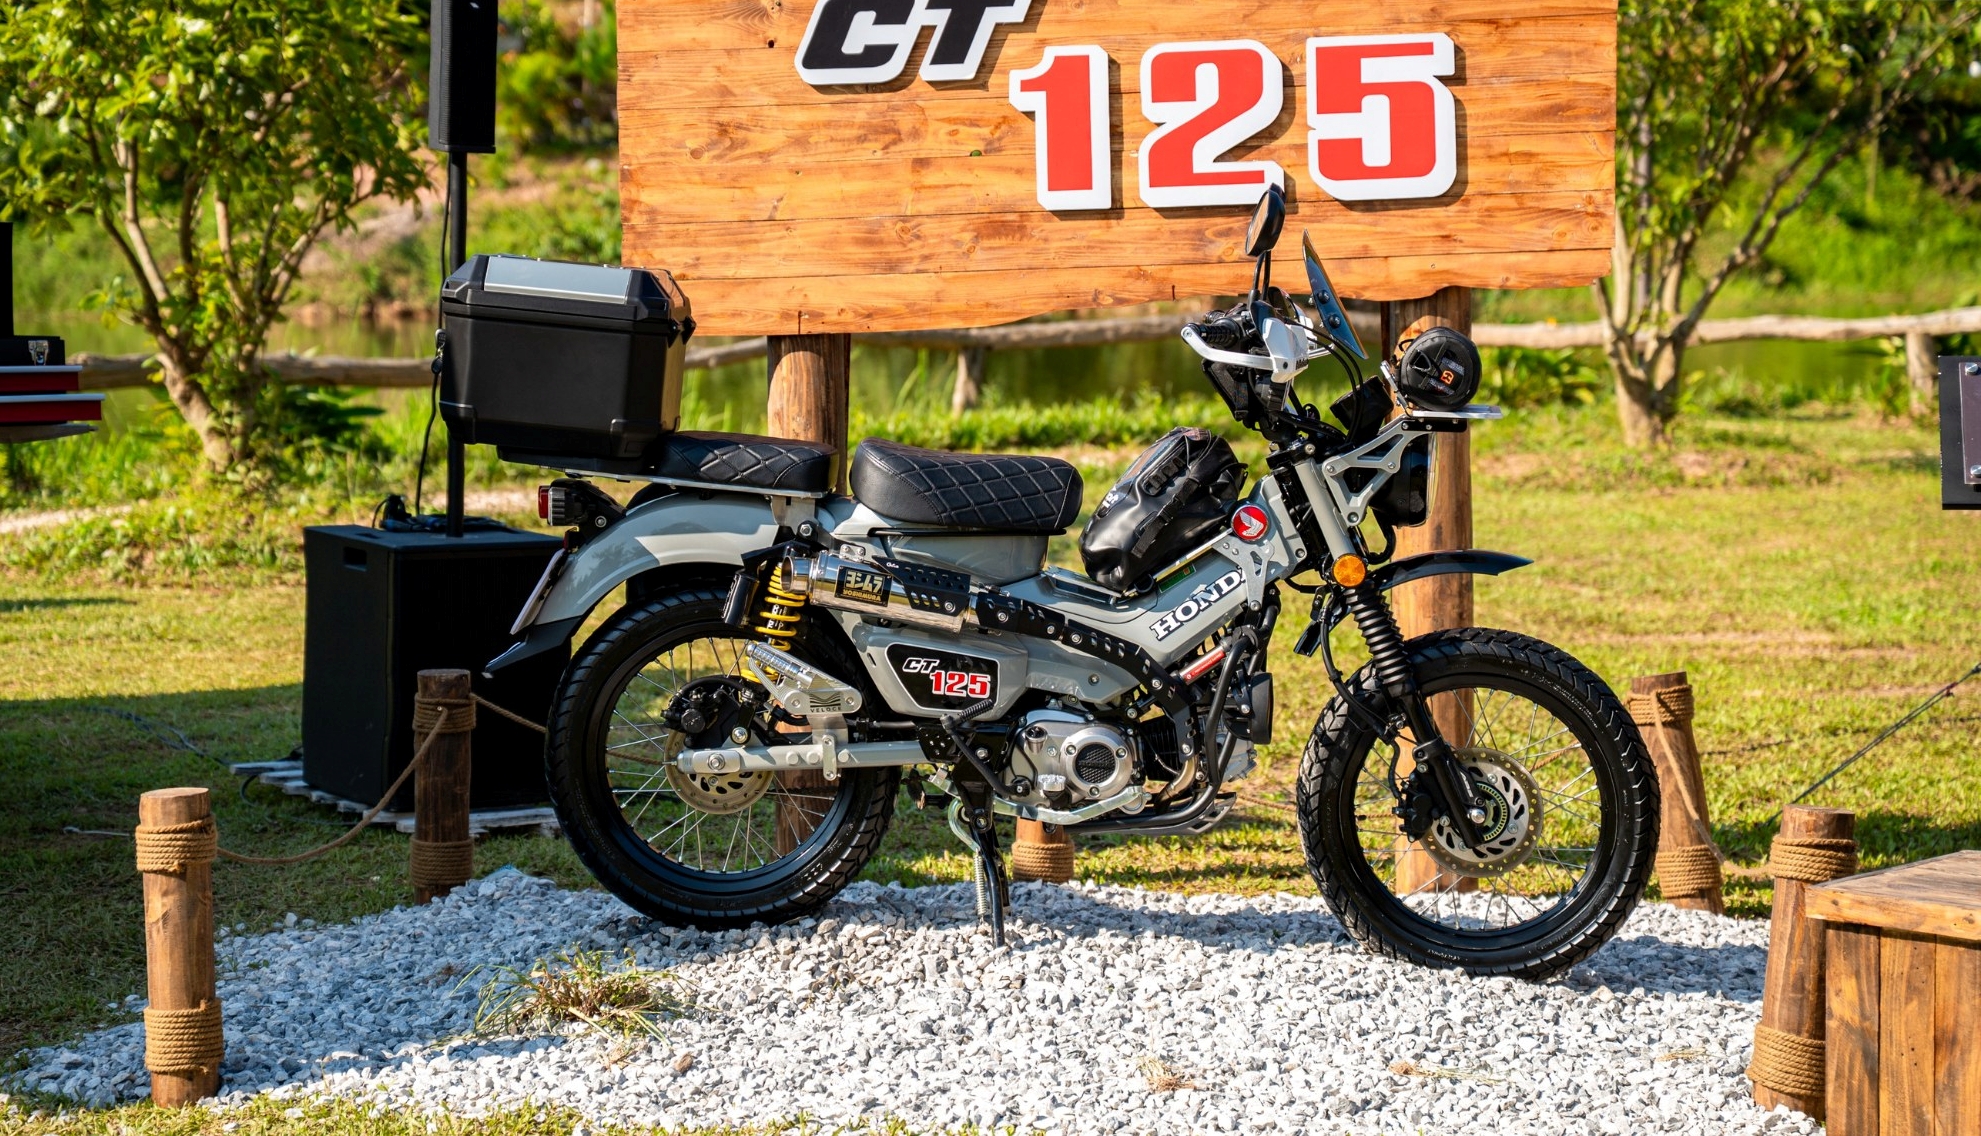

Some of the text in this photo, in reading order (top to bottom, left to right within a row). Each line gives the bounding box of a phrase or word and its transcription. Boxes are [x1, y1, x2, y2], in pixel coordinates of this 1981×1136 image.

[795, 0, 1030, 84] CT
[1009, 32, 1456, 209] 125
[843, 588, 882, 602] YOSHIMURA
[845, 570, 883, 593] ヨシムラ
[1150, 569, 1246, 641] HOND
[903, 657, 940, 673] CT
[929, 670, 991, 698] 125
